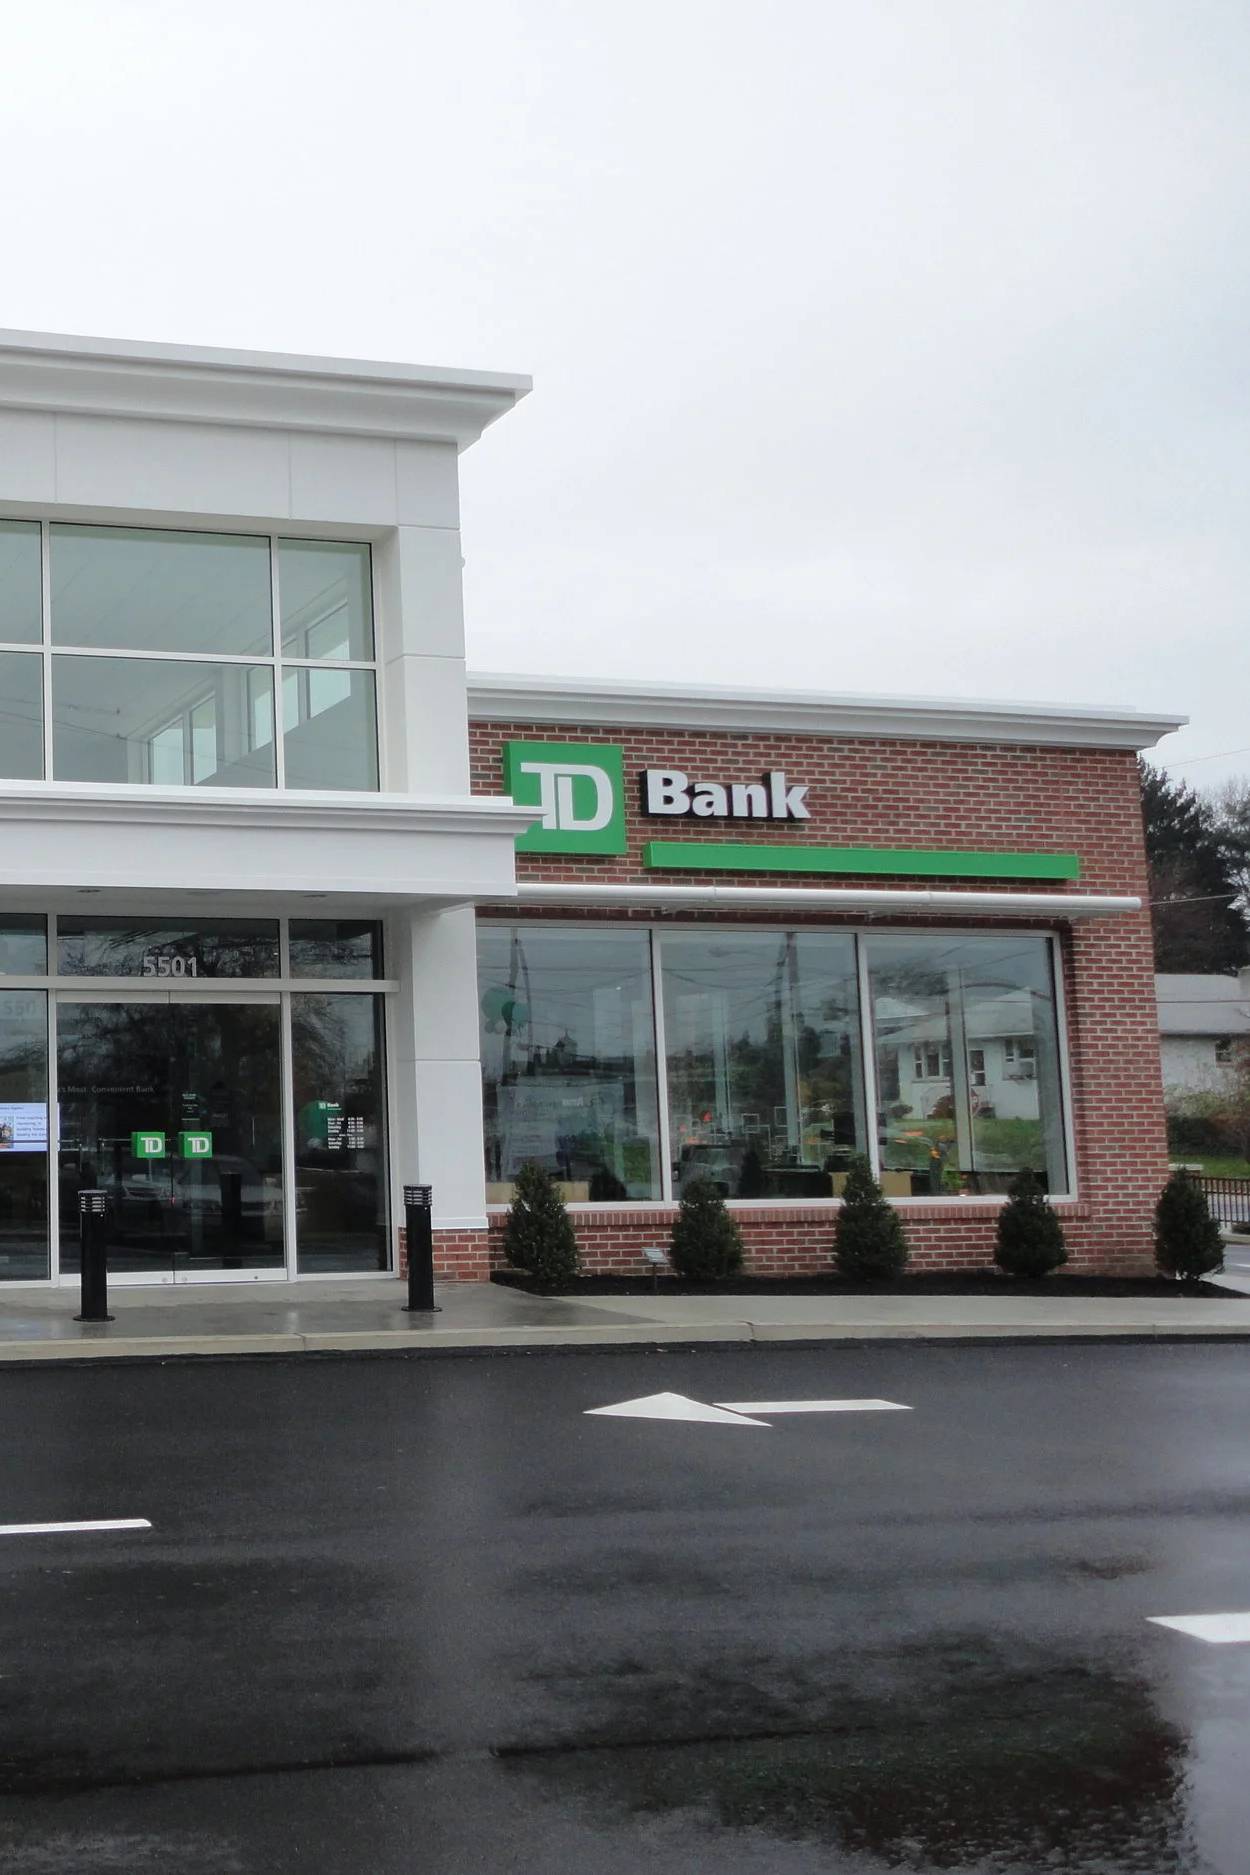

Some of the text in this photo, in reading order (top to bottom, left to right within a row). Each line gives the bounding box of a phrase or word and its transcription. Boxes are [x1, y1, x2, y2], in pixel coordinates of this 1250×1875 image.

[520, 762, 811, 831] TD Bank
[143, 956, 197, 977] 5501
[141, 1137, 163, 1153] TD
[187, 1137, 210, 1153] TD
